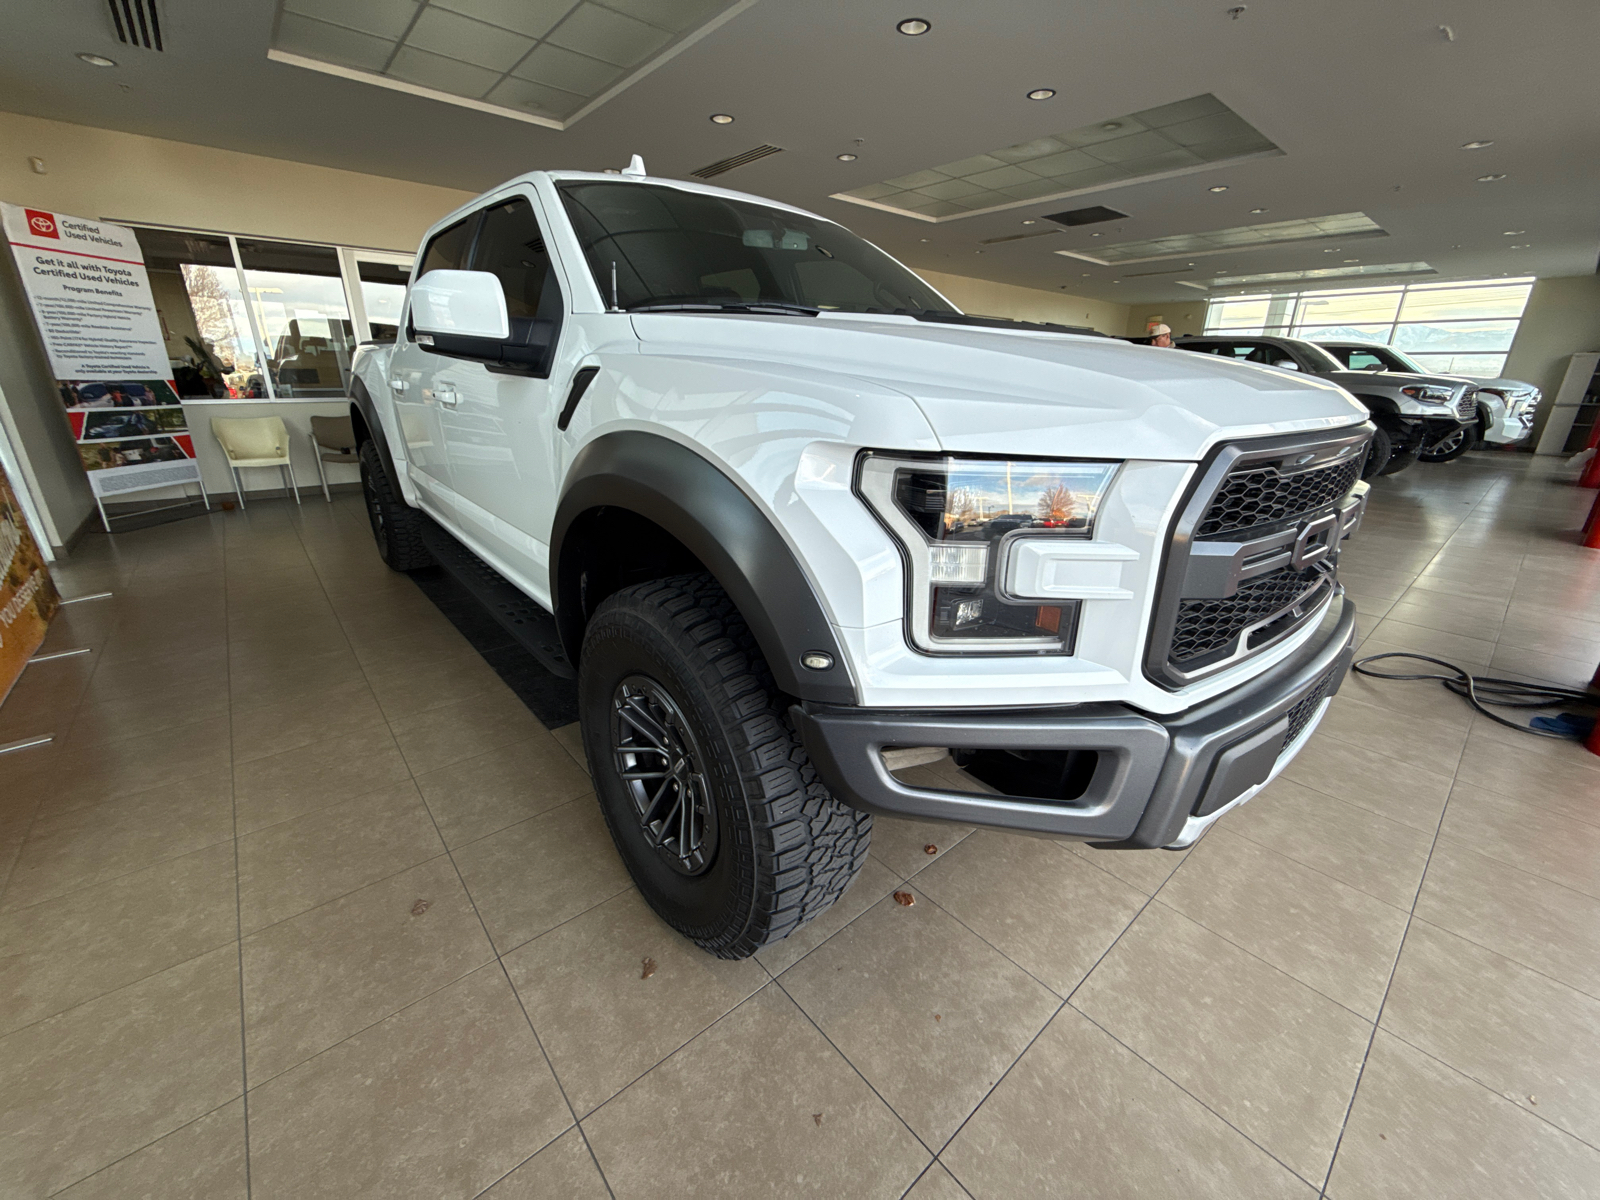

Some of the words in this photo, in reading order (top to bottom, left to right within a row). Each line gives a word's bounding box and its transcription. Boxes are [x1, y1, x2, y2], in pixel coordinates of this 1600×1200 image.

[62, 221, 100, 234] Certified
[64, 230, 88, 241] Used
[88, 234, 123, 247] Vehicles
[35, 256, 56, 266] Get
[56, 259, 65, 267] it
[66, 261, 79, 269] all
[81, 263, 102, 272] with
[102, 266, 132, 276] Toyota
[33, 267, 78, 279] Certified
[79, 272, 103, 282] Used
[103, 275, 139, 287] Vehicles
[62, 284, 95, 294] Program
[95, 288, 123, 297] Benefits
